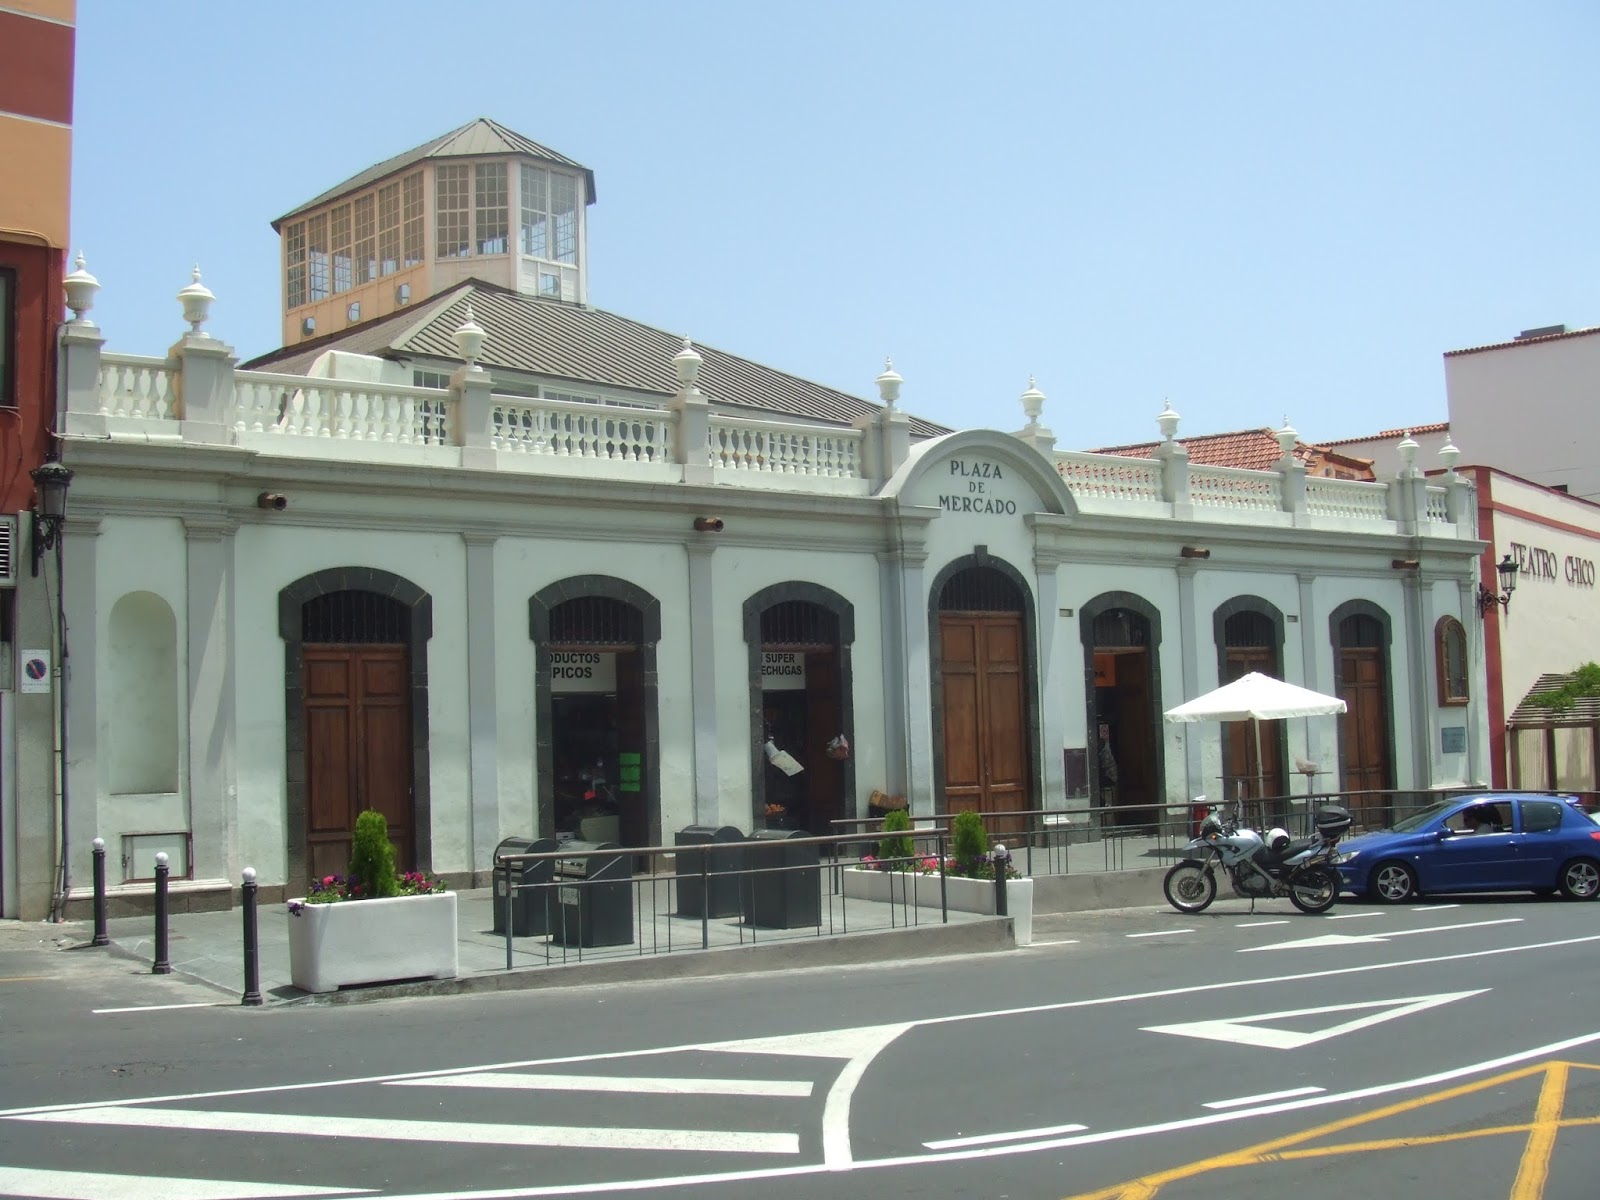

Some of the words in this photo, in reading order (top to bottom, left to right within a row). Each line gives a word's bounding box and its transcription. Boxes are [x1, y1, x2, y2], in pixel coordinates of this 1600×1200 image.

[950, 460, 1002, 479] PLAZA
[968, 481, 985, 494] DE
[939, 495, 1016, 515] MERCADO
[1510, 542, 1558, 580] TEATRO
[1565, 555, 1595, 586] CHICO
[765, 653, 795, 663] SUPER
